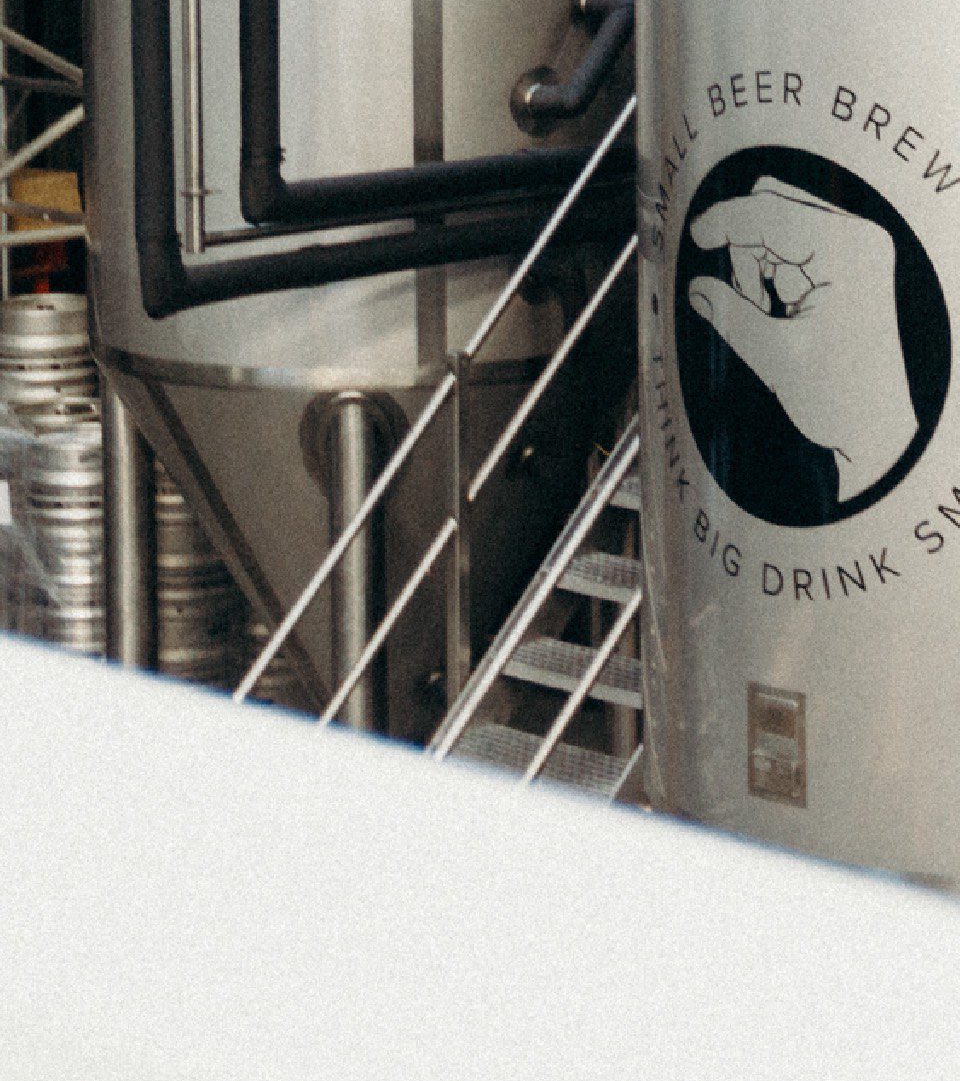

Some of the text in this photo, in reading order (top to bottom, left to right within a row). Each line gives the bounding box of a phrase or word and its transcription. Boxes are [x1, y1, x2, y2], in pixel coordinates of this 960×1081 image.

[652, 113, 699, 253] SMALL
[707, 70, 803, 118] BEER
[693, 508, 742, 577] BIG
[761, 547, 901, 601] DRINK
